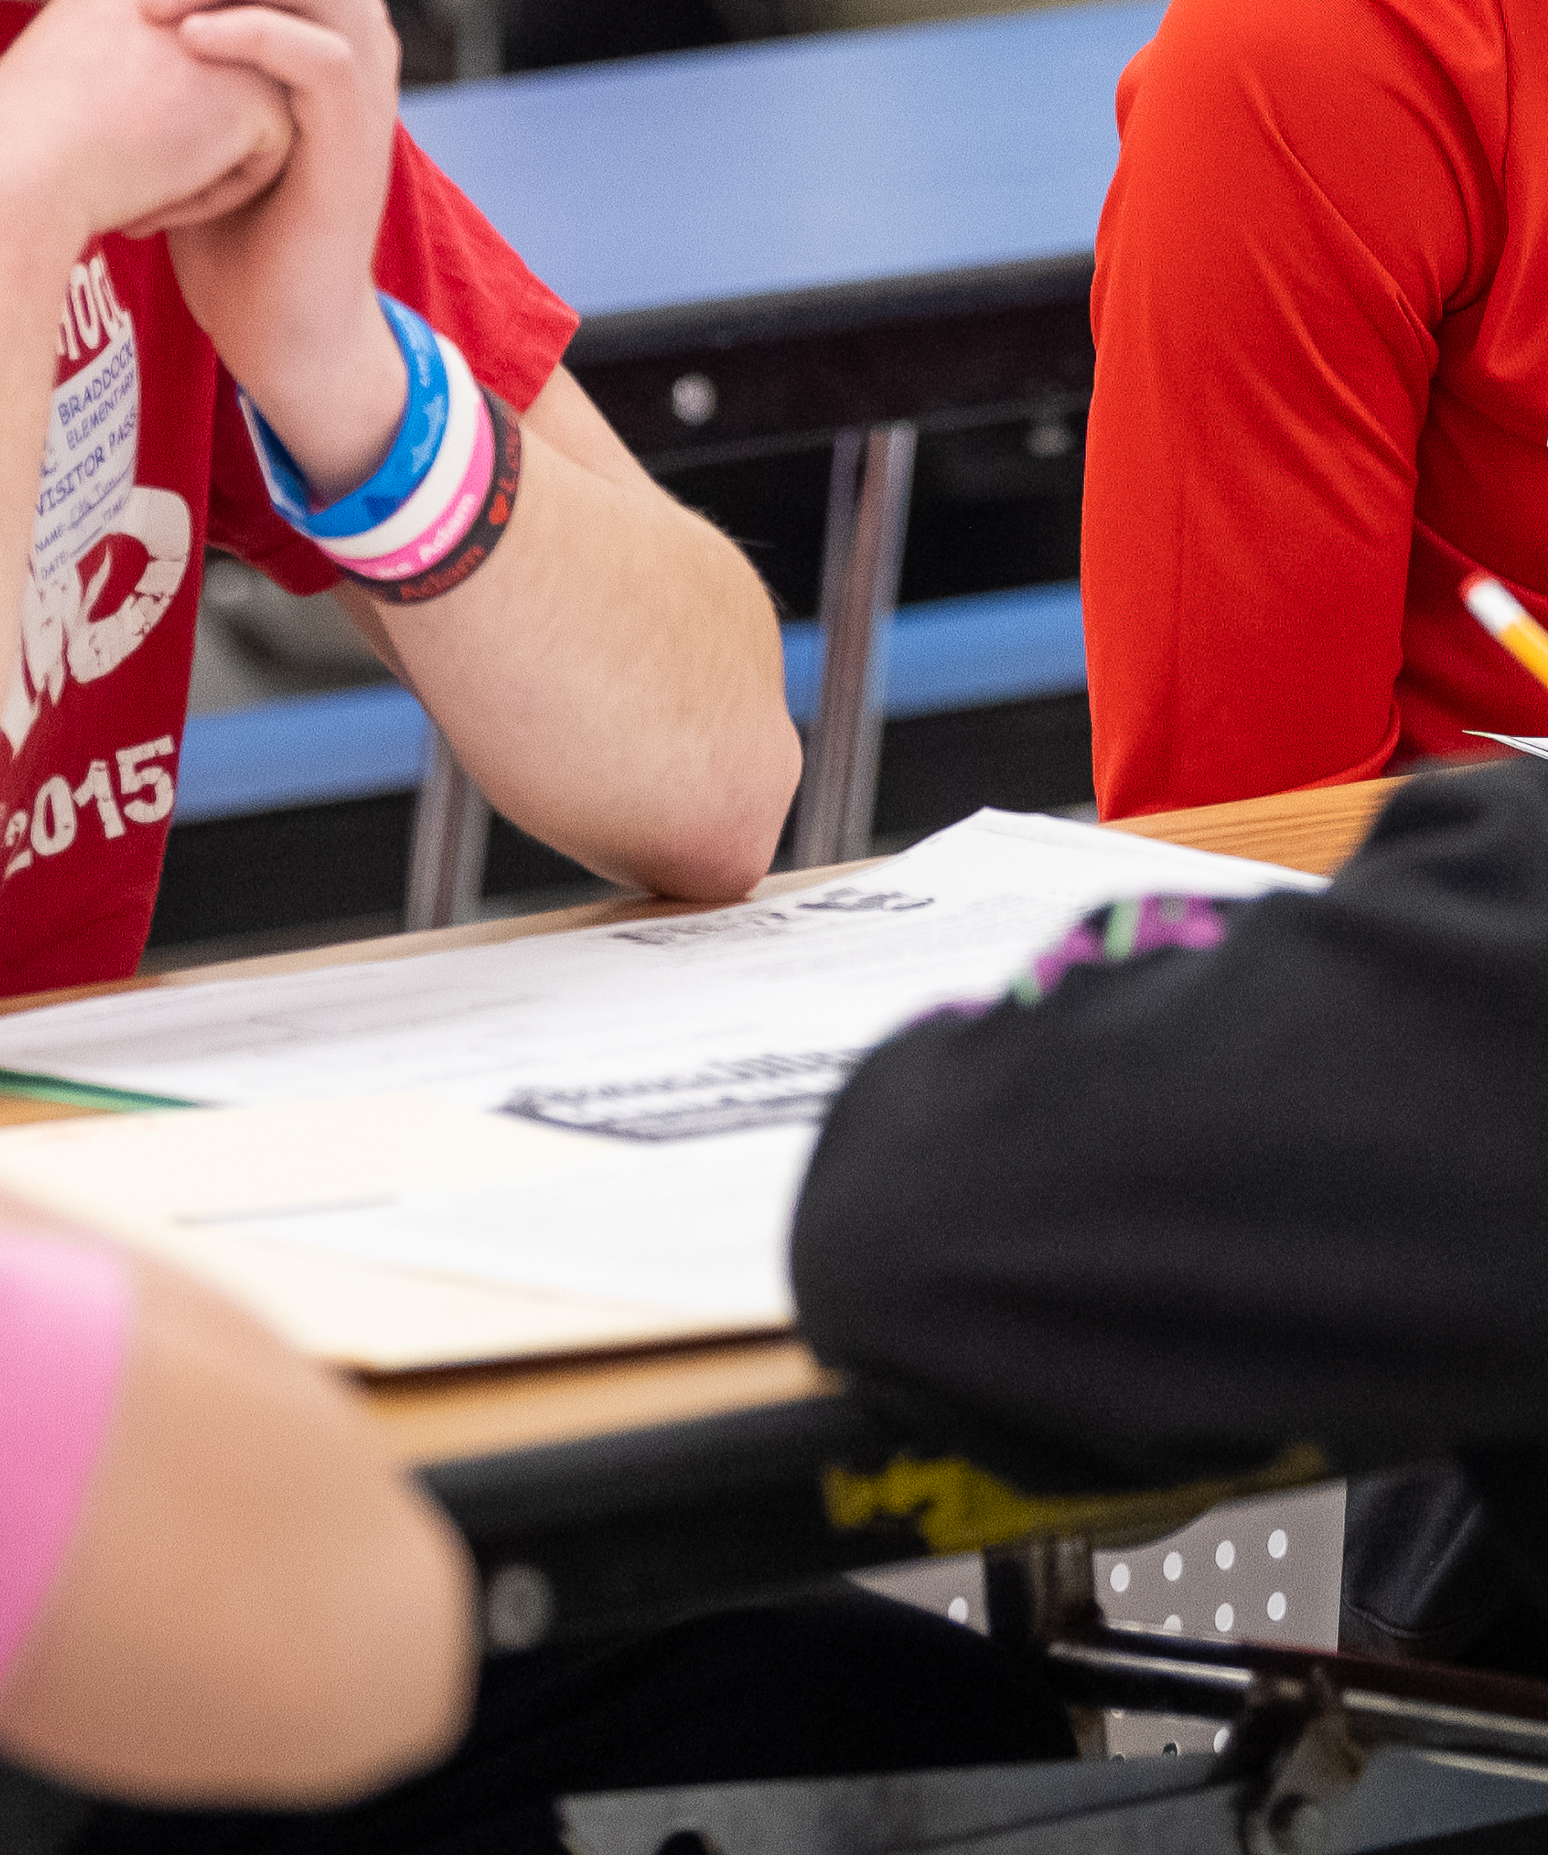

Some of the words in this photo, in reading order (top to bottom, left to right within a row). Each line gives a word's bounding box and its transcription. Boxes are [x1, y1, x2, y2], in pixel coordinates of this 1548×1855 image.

[58, 338, 133, 426] BRADDOCK
[35, 445, 105, 517] VISITOR
[4, 734, 175, 881] 2015
